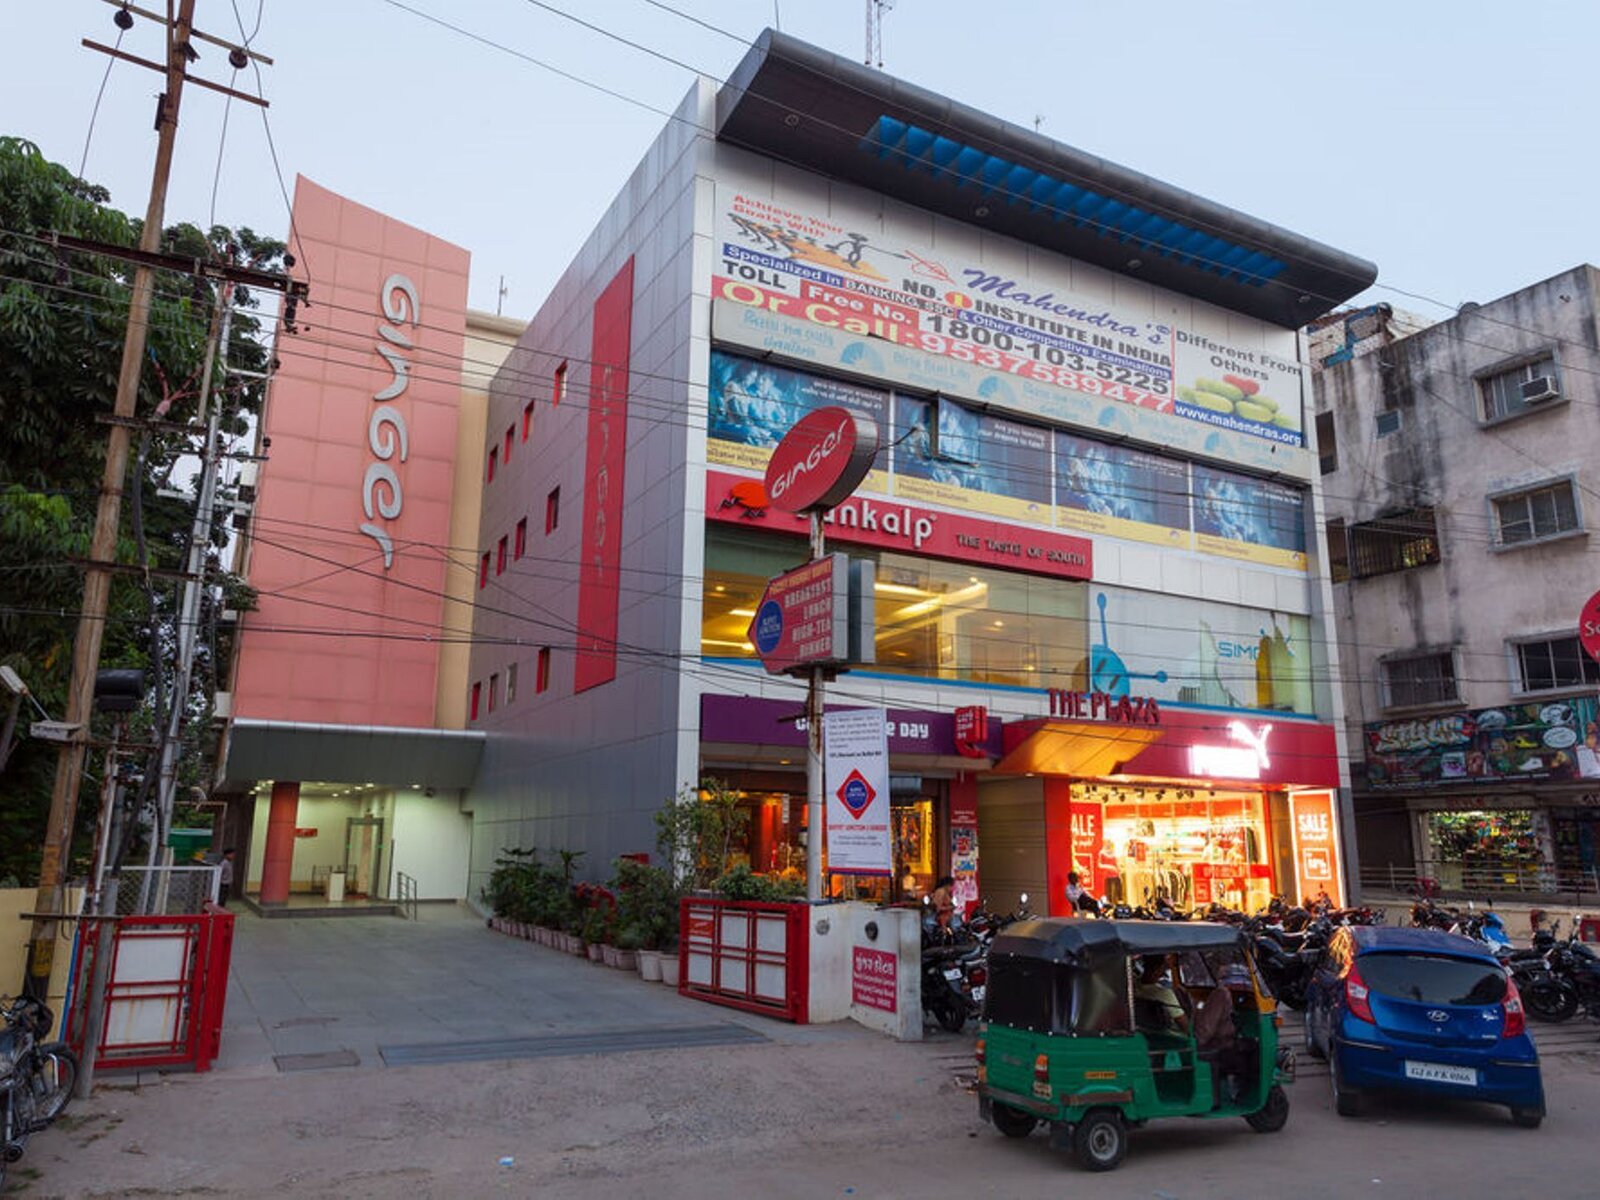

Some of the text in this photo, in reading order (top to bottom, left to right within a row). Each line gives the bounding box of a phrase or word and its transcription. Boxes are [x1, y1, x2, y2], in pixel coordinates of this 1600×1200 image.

[734, 194, 803, 222] Achieve
[787, 220, 826, 238] With
[722, 259, 787, 290] TOLL
[808, 285, 864, 311] Free
[873, 301, 912, 325] No.
[927, 314, 1169, 395] 1800-103-5225
[727, 245, 822, 280] Specialized
[826, 274, 841, 287] in
[973, 314, 1011, 333] Other
[1014, 325, 1090, 358] Competitive
[1092, 347, 1170, 380] Examinations
[902, 278, 943, 302] NO.
[975, 299, 1088, 343] INSTITUTE
[1093, 333, 1113, 350] IN
[1119, 341, 1172, 367] INDIA
[722, 281, 789, 312] Or
[920, 333, 1172, 412] 9537589477
[1176, 330, 1302, 375] Different From
[1210, 355, 1270, 381] Others
[1174, 405, 1302, 447] www.mahendras.org
[957, 533, 980, 549] THE
[984, 538, 1021, 557] TASTE
[1026, 545, 1044, 560] OF
[1047, 550, 1086, 566] SOUTH
[784, 577, 832, 609] BREAKFAST
[1047, 687, 1161, 726] THE PLAZA
[1070, 813, 1096, 837] ALE
[1298, 814, 1329, 833] SALE
